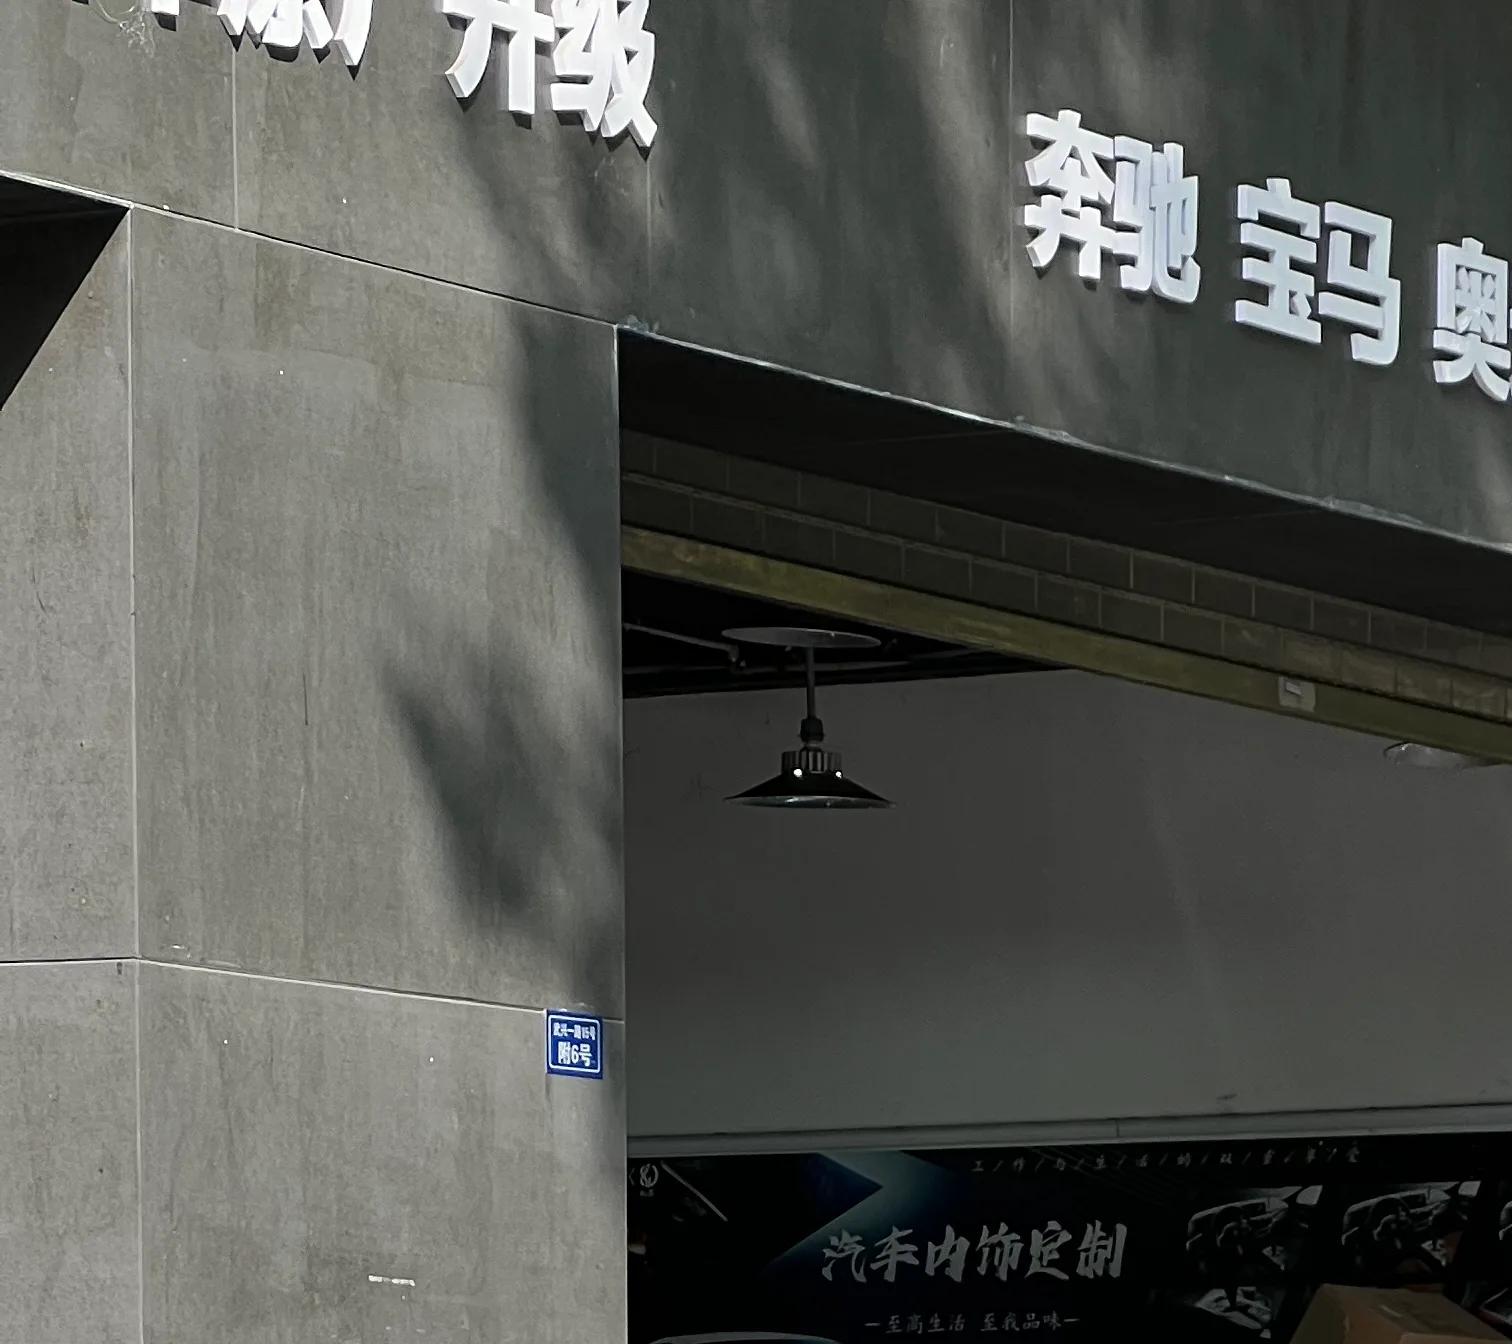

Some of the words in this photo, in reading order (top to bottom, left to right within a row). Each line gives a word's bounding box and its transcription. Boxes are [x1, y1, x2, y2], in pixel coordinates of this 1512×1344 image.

[1024, 109, 1201, 303] 奔驰
[1235, 178, 1401, 366] 宝马
[821, 1220, 1128, 1283] 汽车内饰定制
